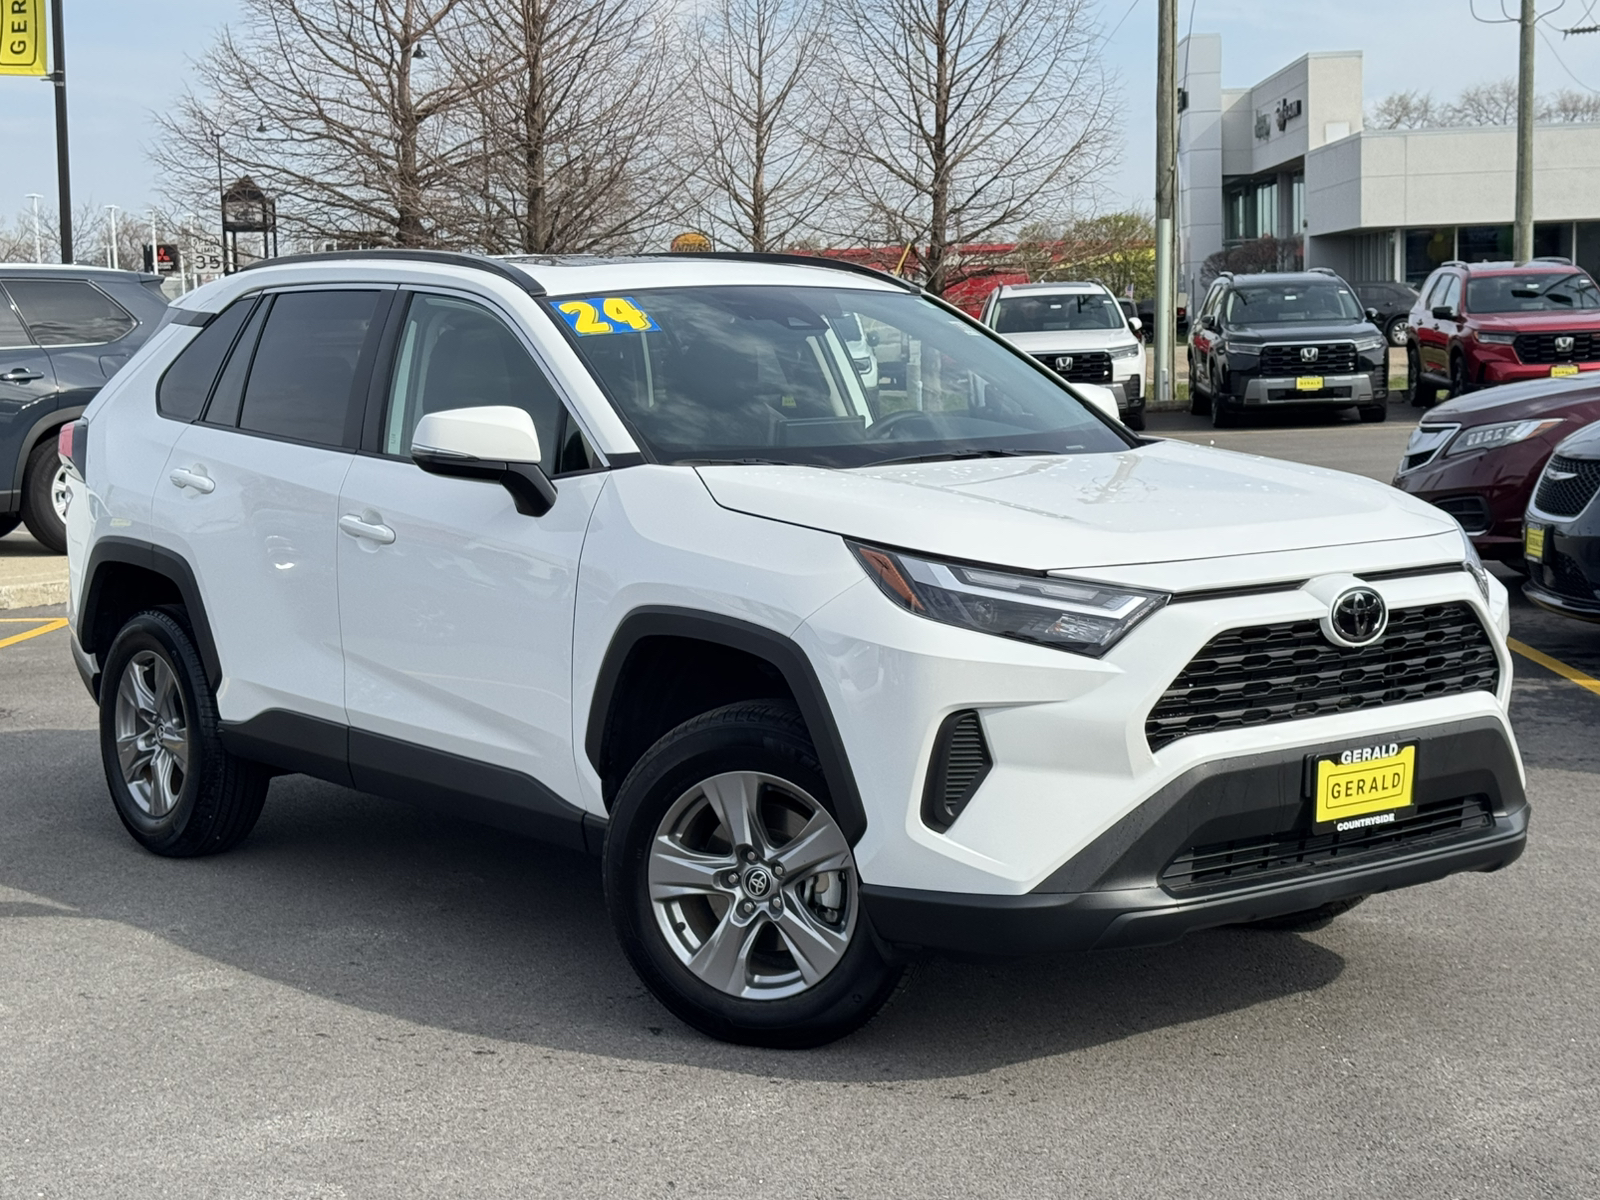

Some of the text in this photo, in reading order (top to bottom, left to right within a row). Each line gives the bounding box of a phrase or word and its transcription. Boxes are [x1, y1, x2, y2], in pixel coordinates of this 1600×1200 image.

[10, 0, 27, 55] GER
[196, 255, 221, 270] 35
[558, 298, 652, 334] 24
[1341, 743, 1399, 765] GERALD
[1331, 772, 1401, 799] GERALD
[1337, 812, 1395, 832] COUNTRYSIDE
